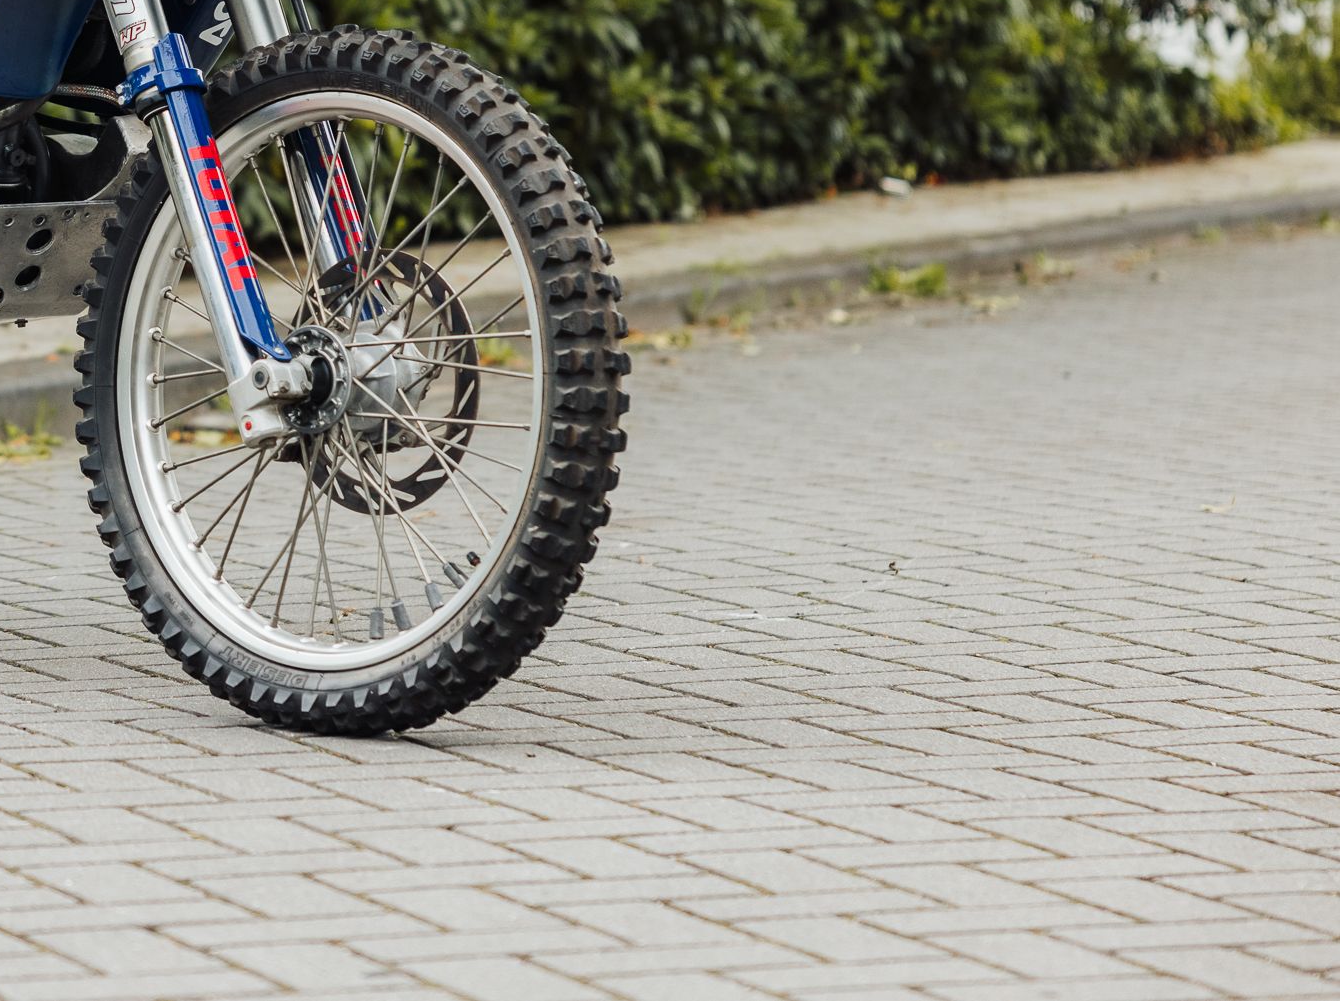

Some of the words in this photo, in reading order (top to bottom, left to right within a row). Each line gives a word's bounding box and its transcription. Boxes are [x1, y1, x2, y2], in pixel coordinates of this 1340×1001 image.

[120, 21, 147, 49] WP
[187, 135, 258, 292] TOTAL
[219, 645, 310, 687] DESERT
